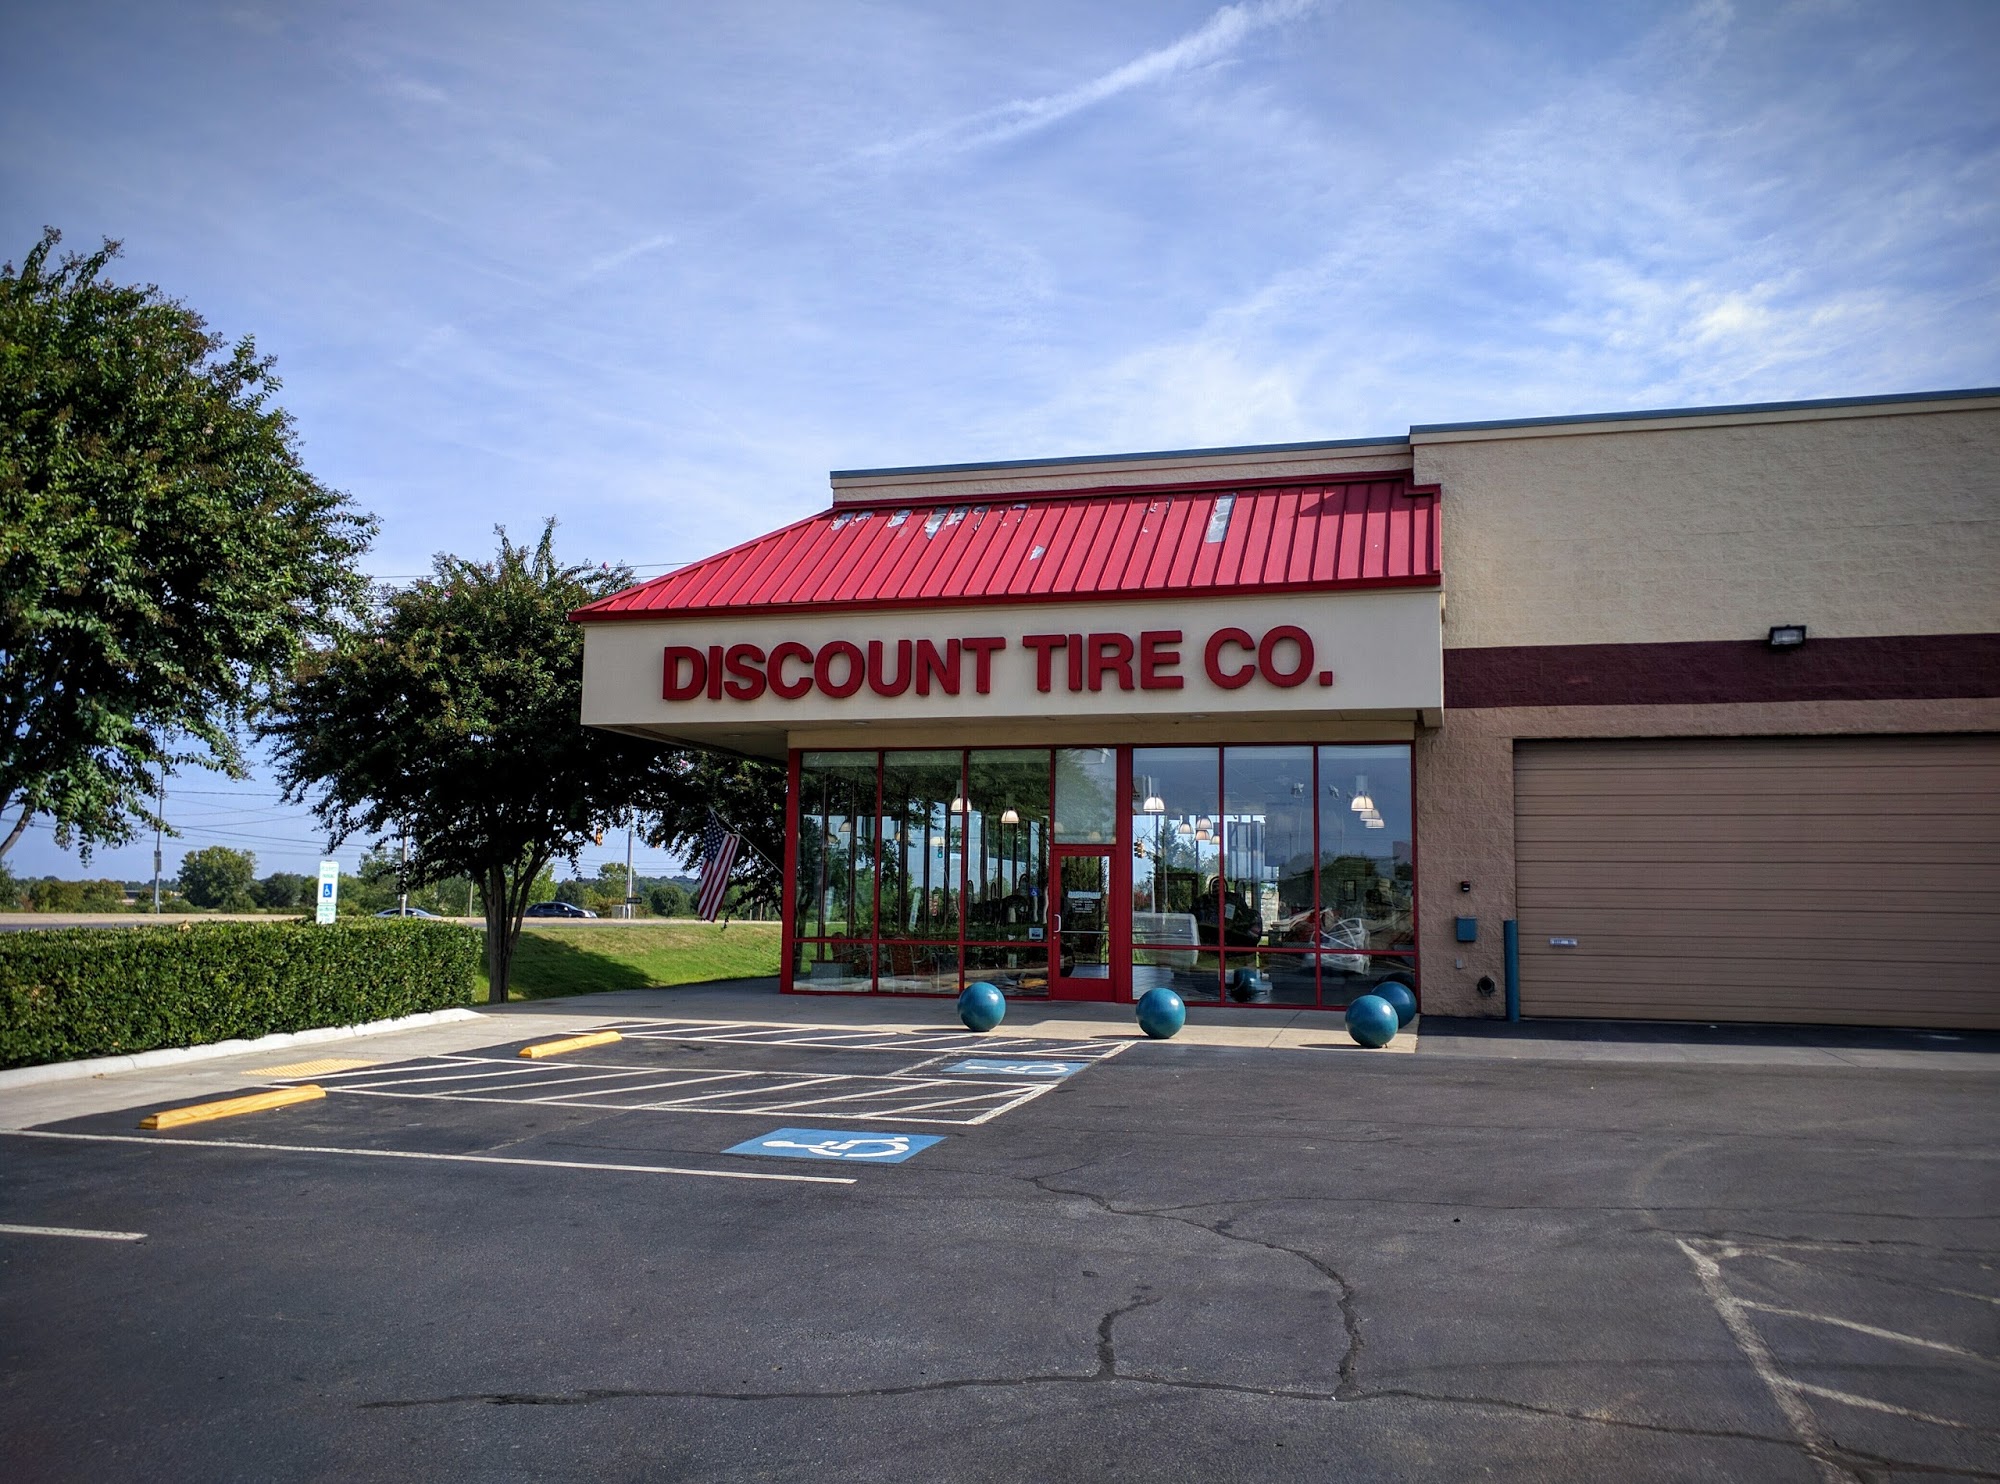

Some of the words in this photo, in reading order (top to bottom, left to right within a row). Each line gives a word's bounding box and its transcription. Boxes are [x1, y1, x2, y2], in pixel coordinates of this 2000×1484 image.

[663, 638, 1007, 700] DISCOUNT
[1023, 631, 1184, 691] TIRE
[1204, 625, 1333, 688] CO.
